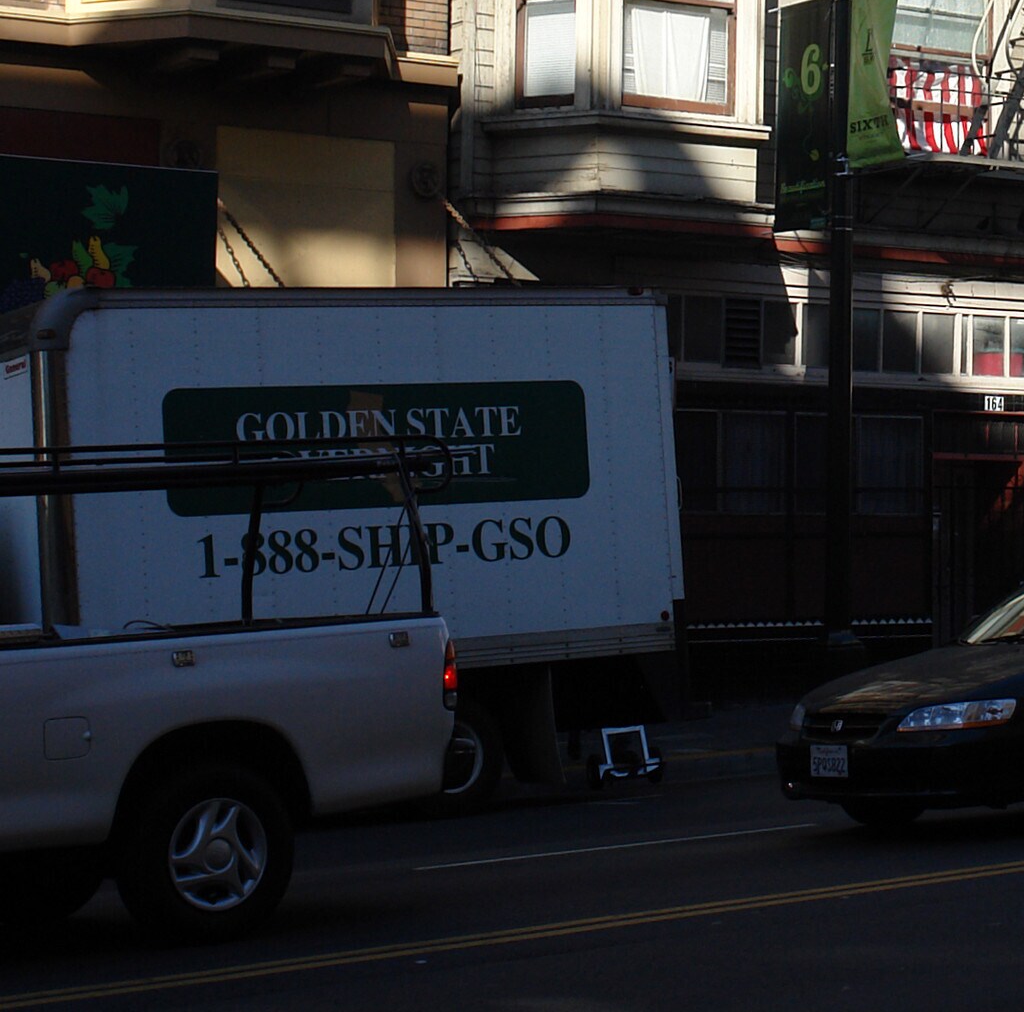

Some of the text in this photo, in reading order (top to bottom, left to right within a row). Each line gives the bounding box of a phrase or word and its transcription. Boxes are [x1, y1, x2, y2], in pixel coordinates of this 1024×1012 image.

[801, 43, 821, 95] 6
[236, 405, 523, 444] GOLDEN STATE
[986, 397, 1003, 410] 164
[197, 515, 571, 579] 1-888-SHIP-GSO
